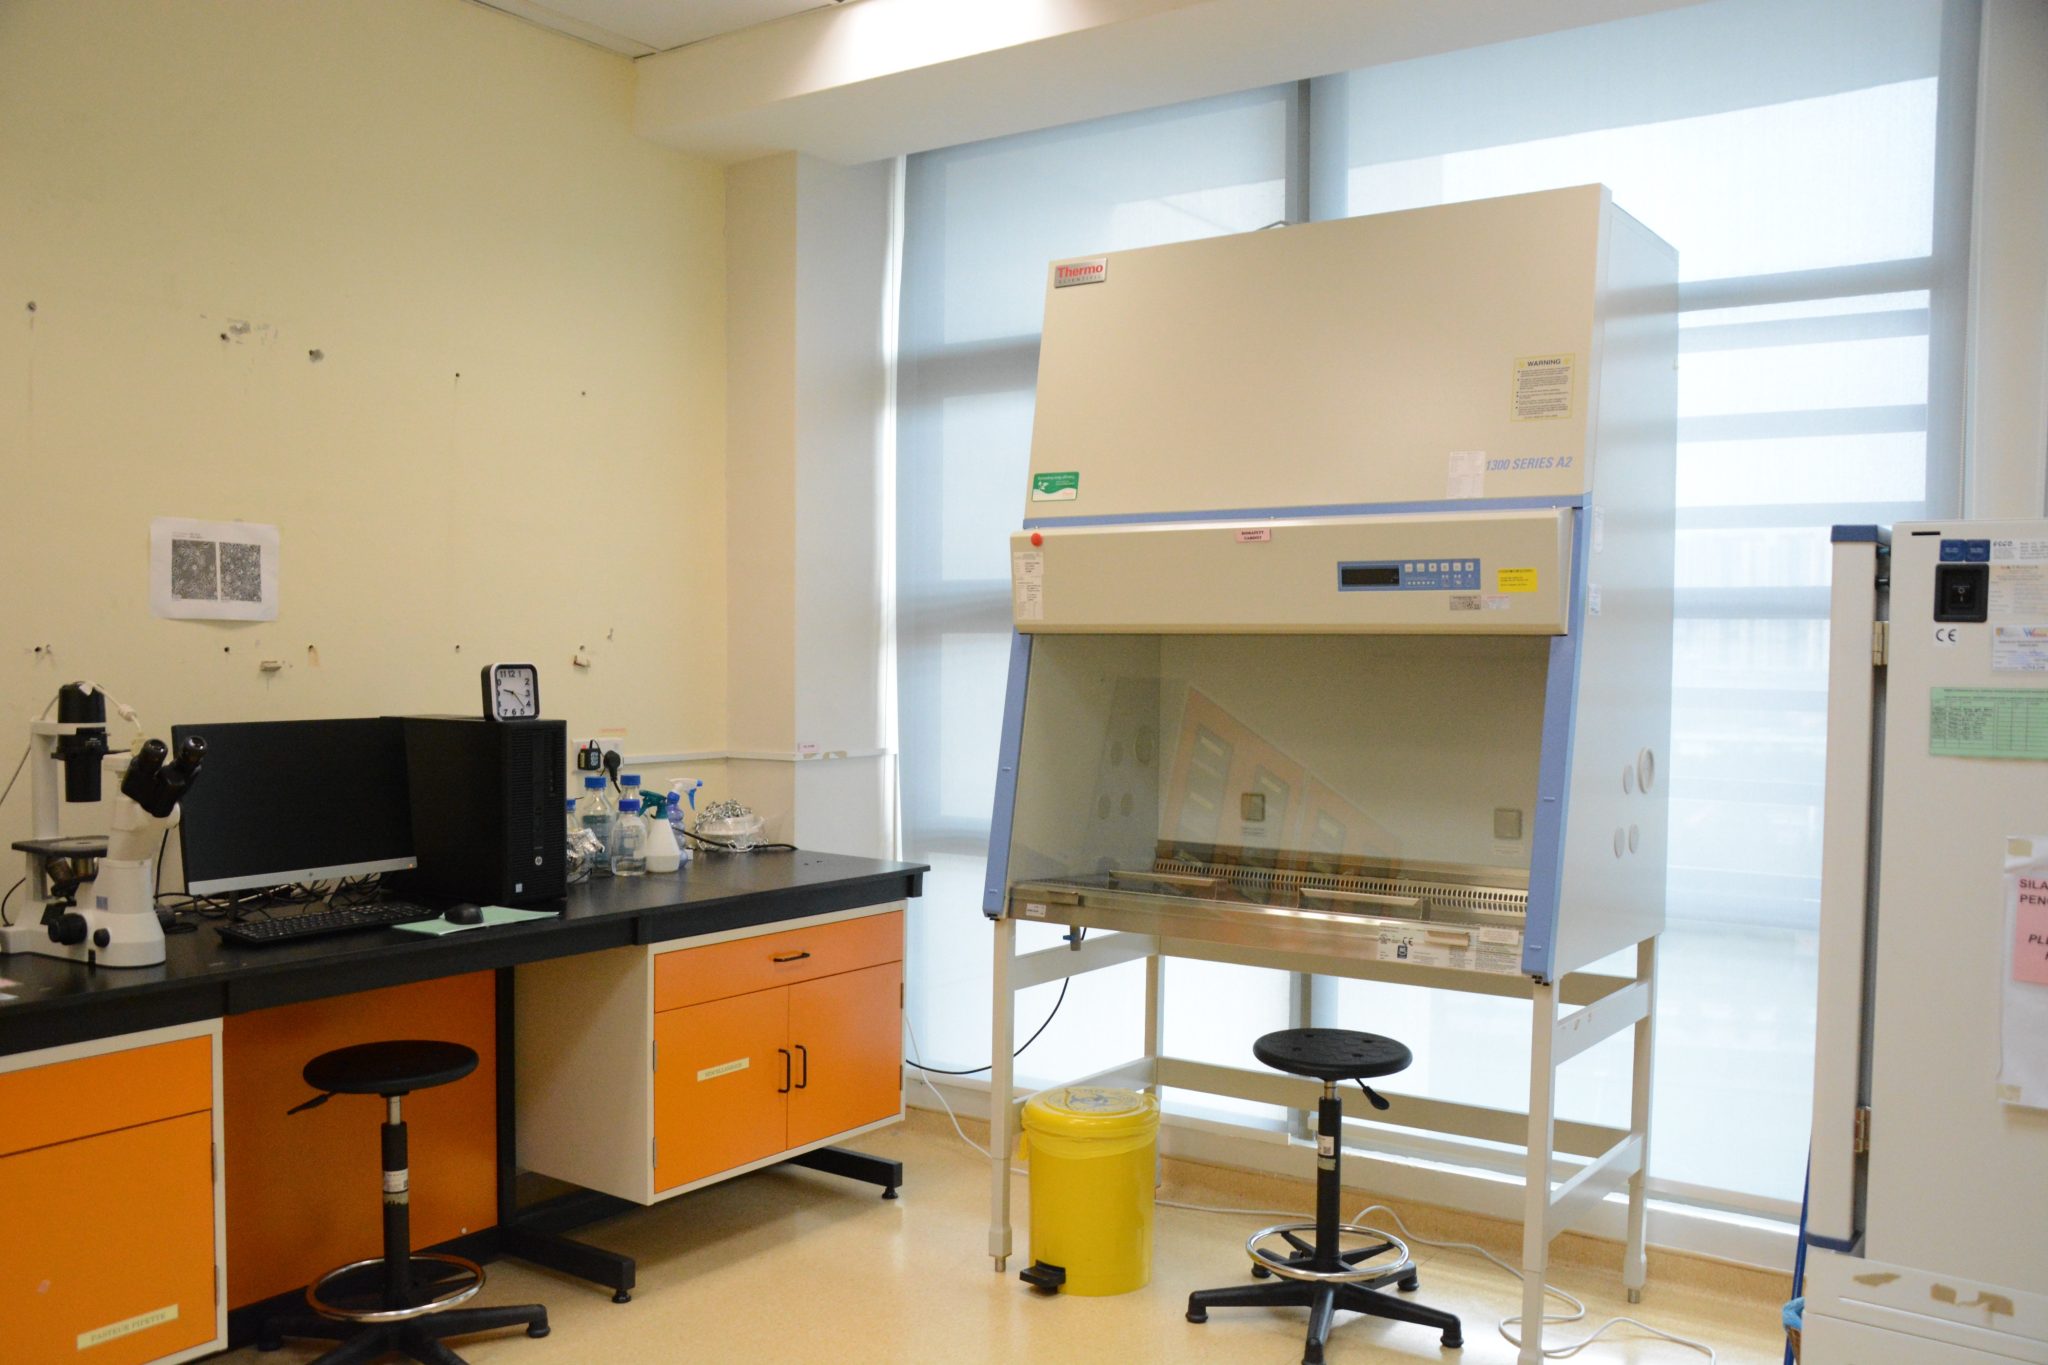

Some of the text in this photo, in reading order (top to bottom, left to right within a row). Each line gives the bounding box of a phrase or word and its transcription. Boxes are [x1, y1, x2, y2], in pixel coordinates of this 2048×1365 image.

[1057, 265, 1103, 280] Thermo
[1527, 359, 1561, 367] WARNING
[1486, 455, 1573, 471] 1300 SERIES A2
[508, 670, 515, 678] 12
[524, 678, 530, 686] 2
[2020, 894, 2048, 905] PEN
